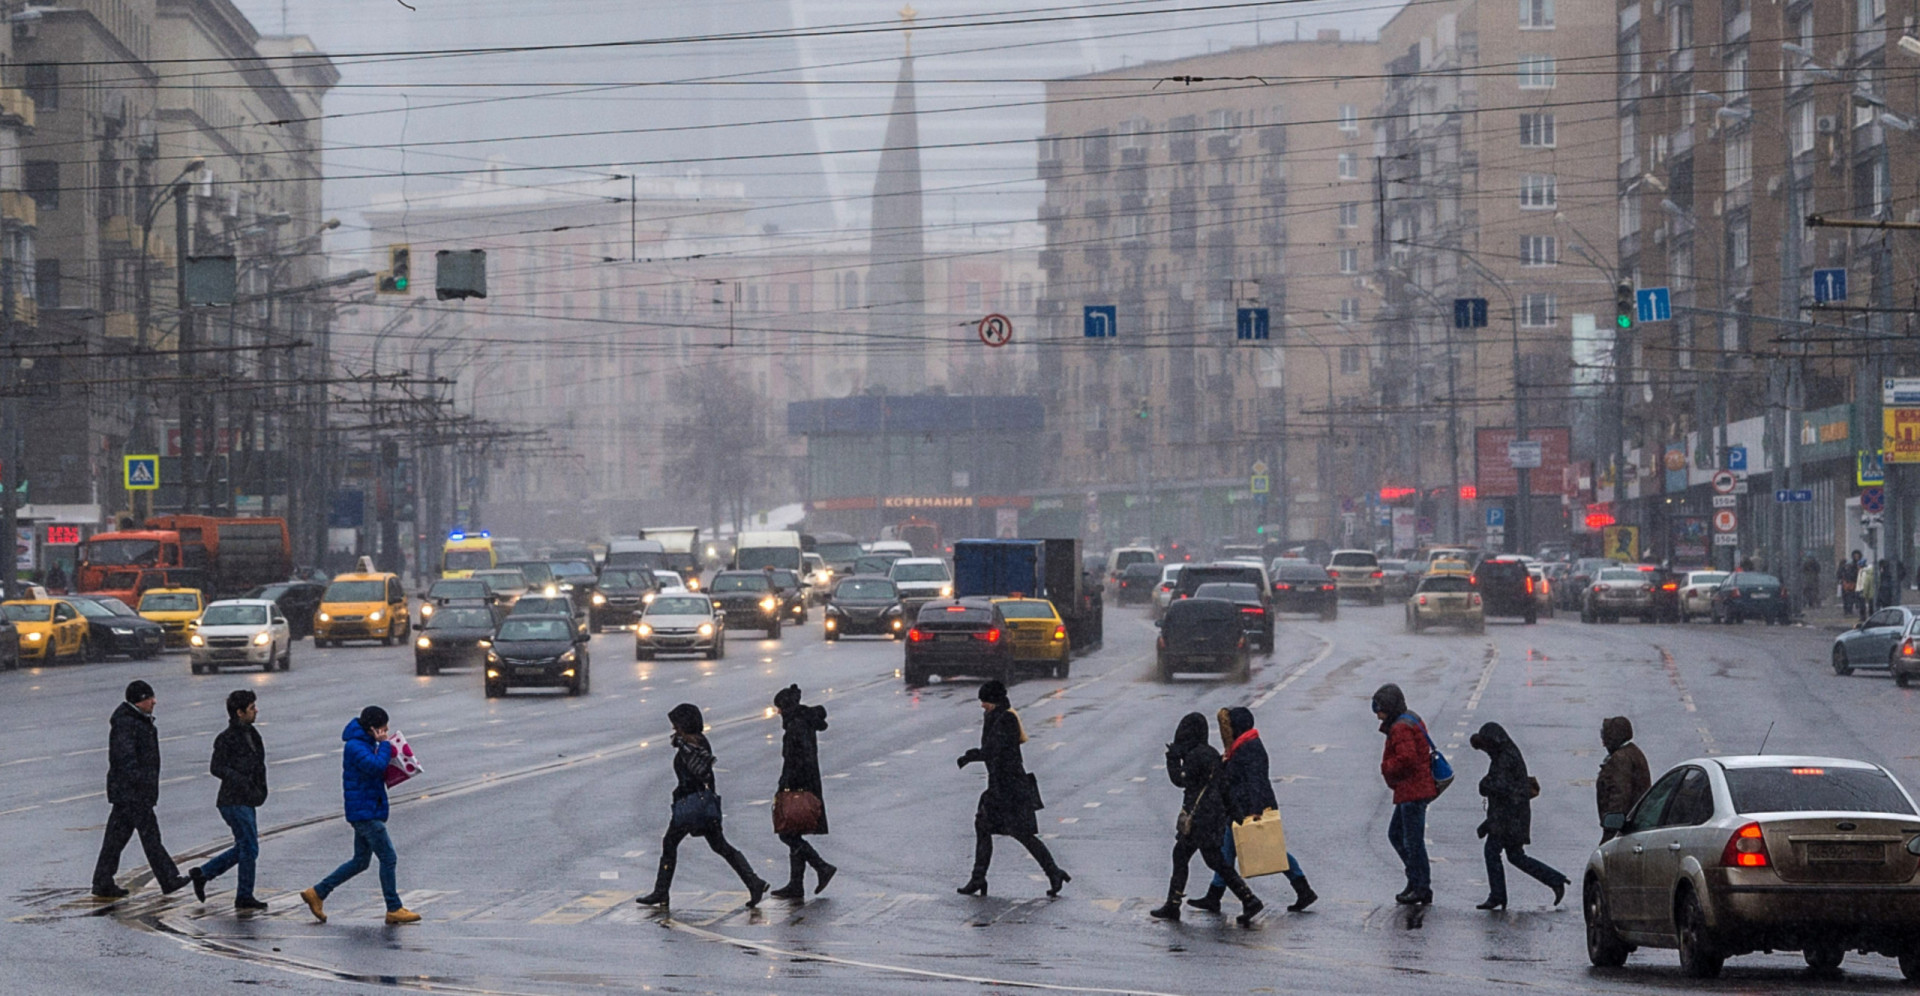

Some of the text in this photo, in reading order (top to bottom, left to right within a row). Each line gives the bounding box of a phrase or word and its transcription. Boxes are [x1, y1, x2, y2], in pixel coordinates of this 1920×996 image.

[1729, 450, 1742, 468] P
[884, 496, 973, 508] КОФЕМАНИЯ
[1490, 509, 1501, 524] P
